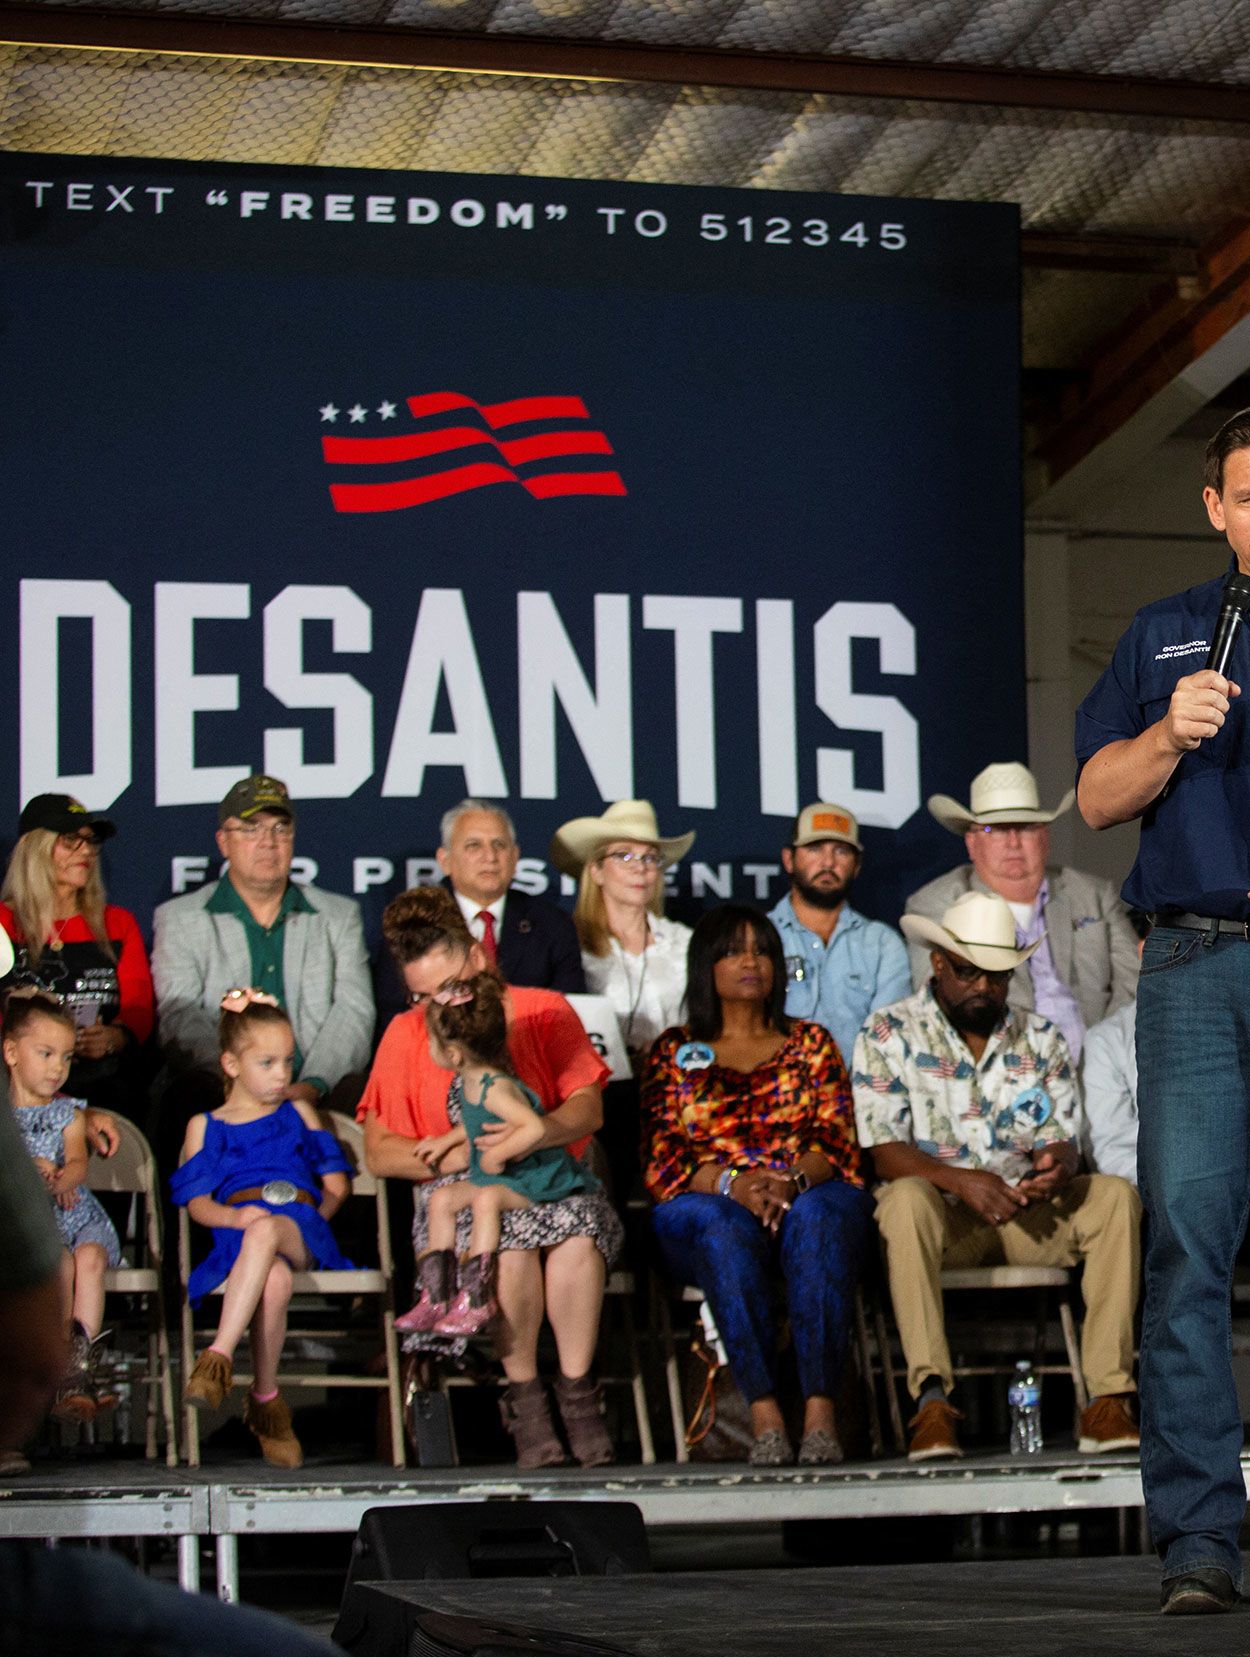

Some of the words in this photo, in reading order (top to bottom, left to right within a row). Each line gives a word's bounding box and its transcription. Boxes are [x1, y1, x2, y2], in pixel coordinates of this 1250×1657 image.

[26, 181, 175, 214] TEXT
[597, 206, 668, 238] TO
[699, 212, 907, 250] 512345
[1155, 652, 1173, 661] RON
[1162, 640, 1207, 653] GOVERNOR
[18, 578, 920, 830] DESANTIS
